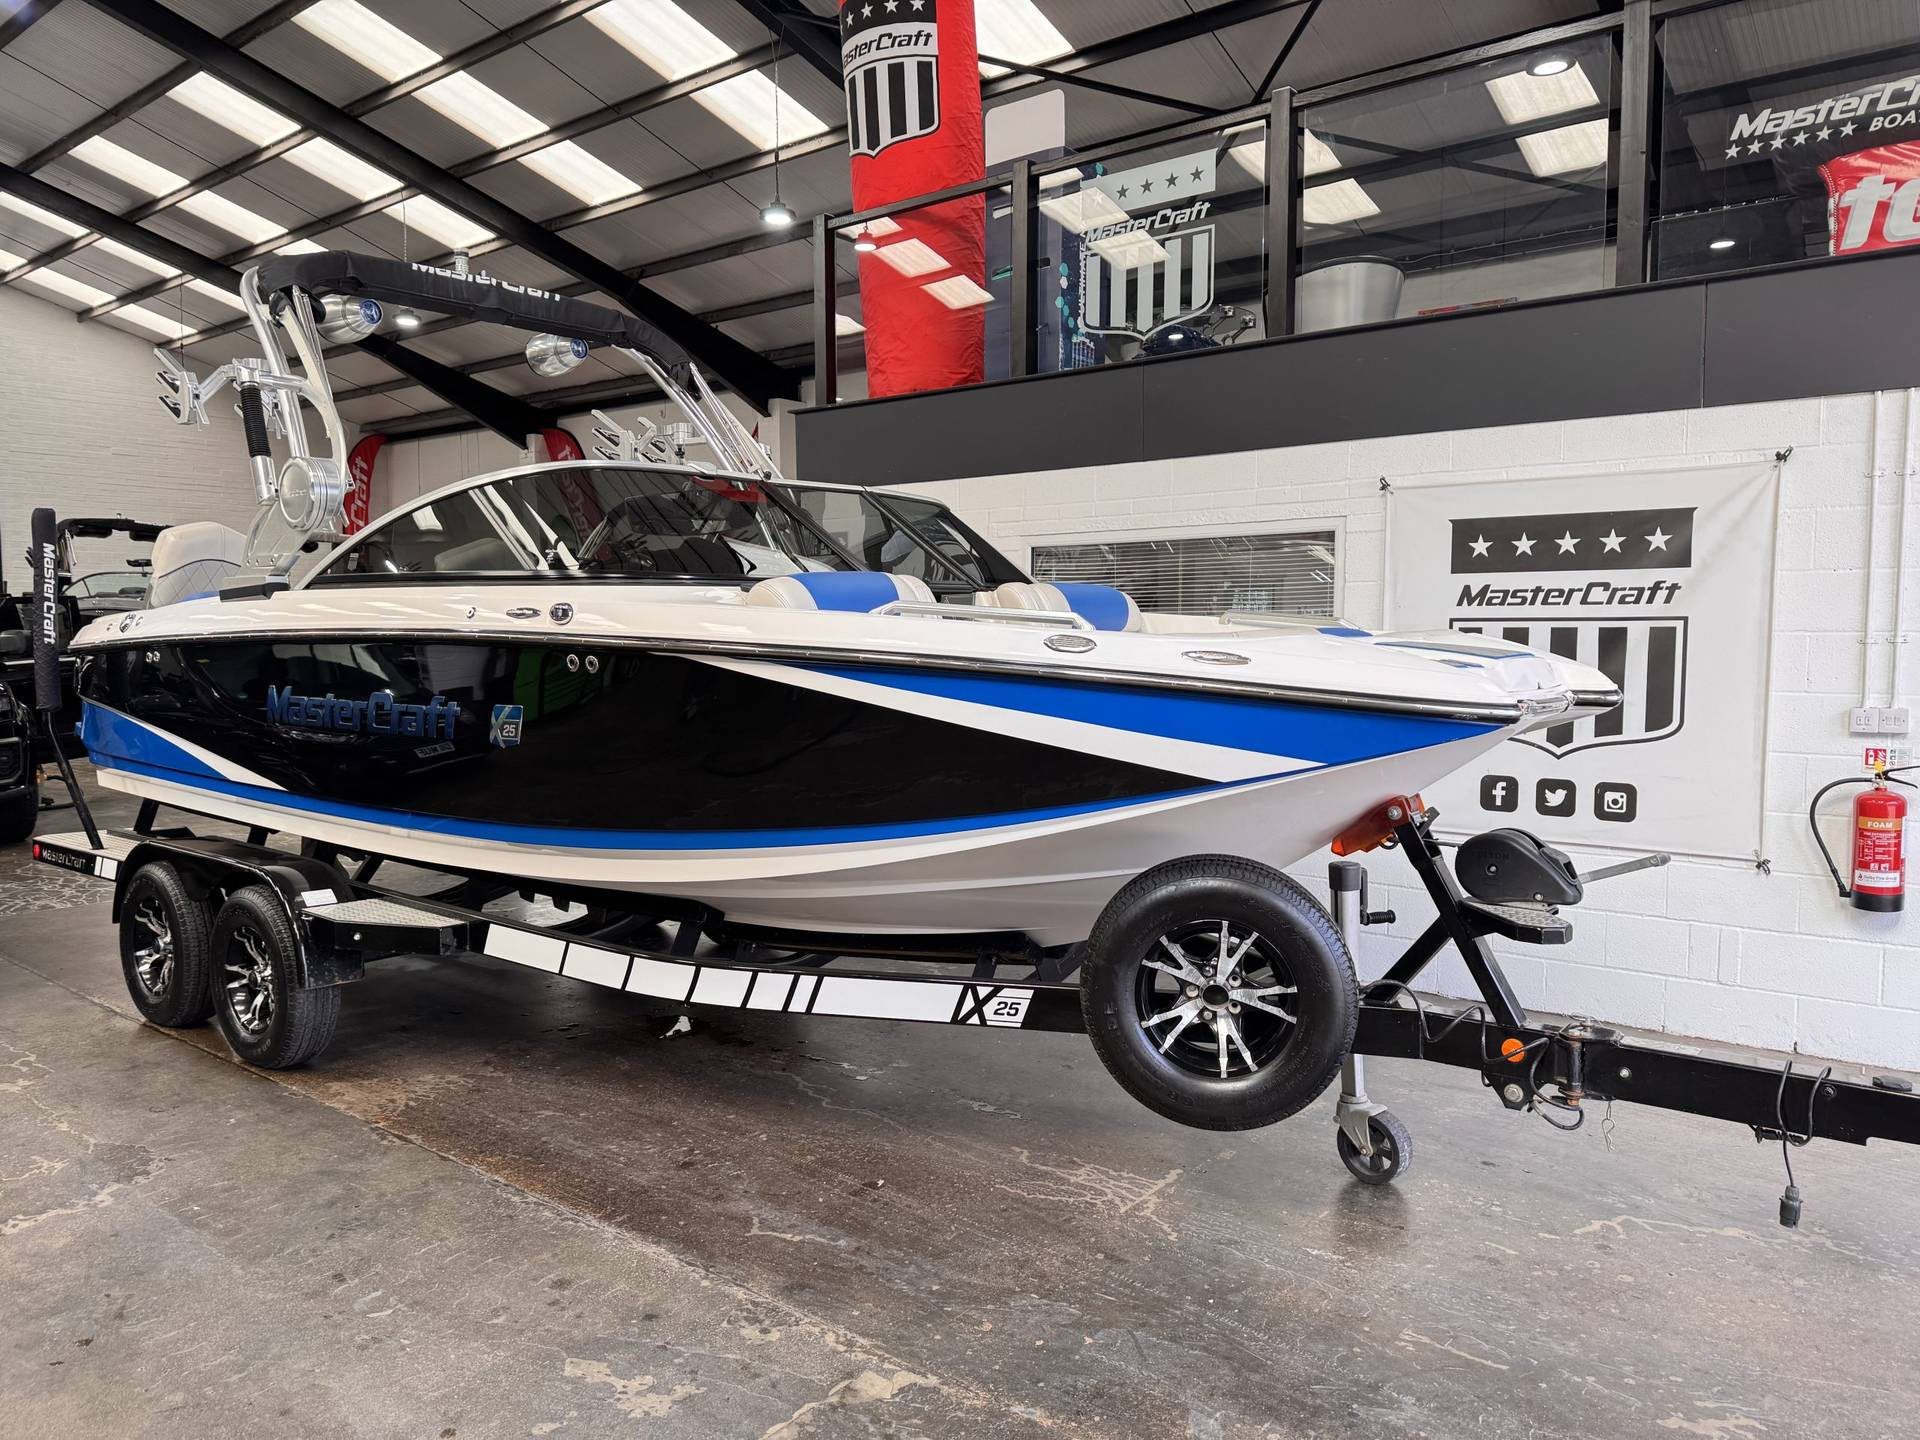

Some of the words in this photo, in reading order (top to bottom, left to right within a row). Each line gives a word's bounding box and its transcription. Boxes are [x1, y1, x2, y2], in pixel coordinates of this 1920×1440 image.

[843, 30, 932, 68] asterCraft
[1730, 78, 1920, 141] MasterCr
[1869, 108, 1920, 132] BOA
[350, 456, 369, 533] Craft
[43, 542, 56, 645] MasterCraft
[1456, 580, 1682, 607] MasterCraft
[266, 685, 461, 738] MasterCraft
[1867, 821, 1893, 829] FOAM
